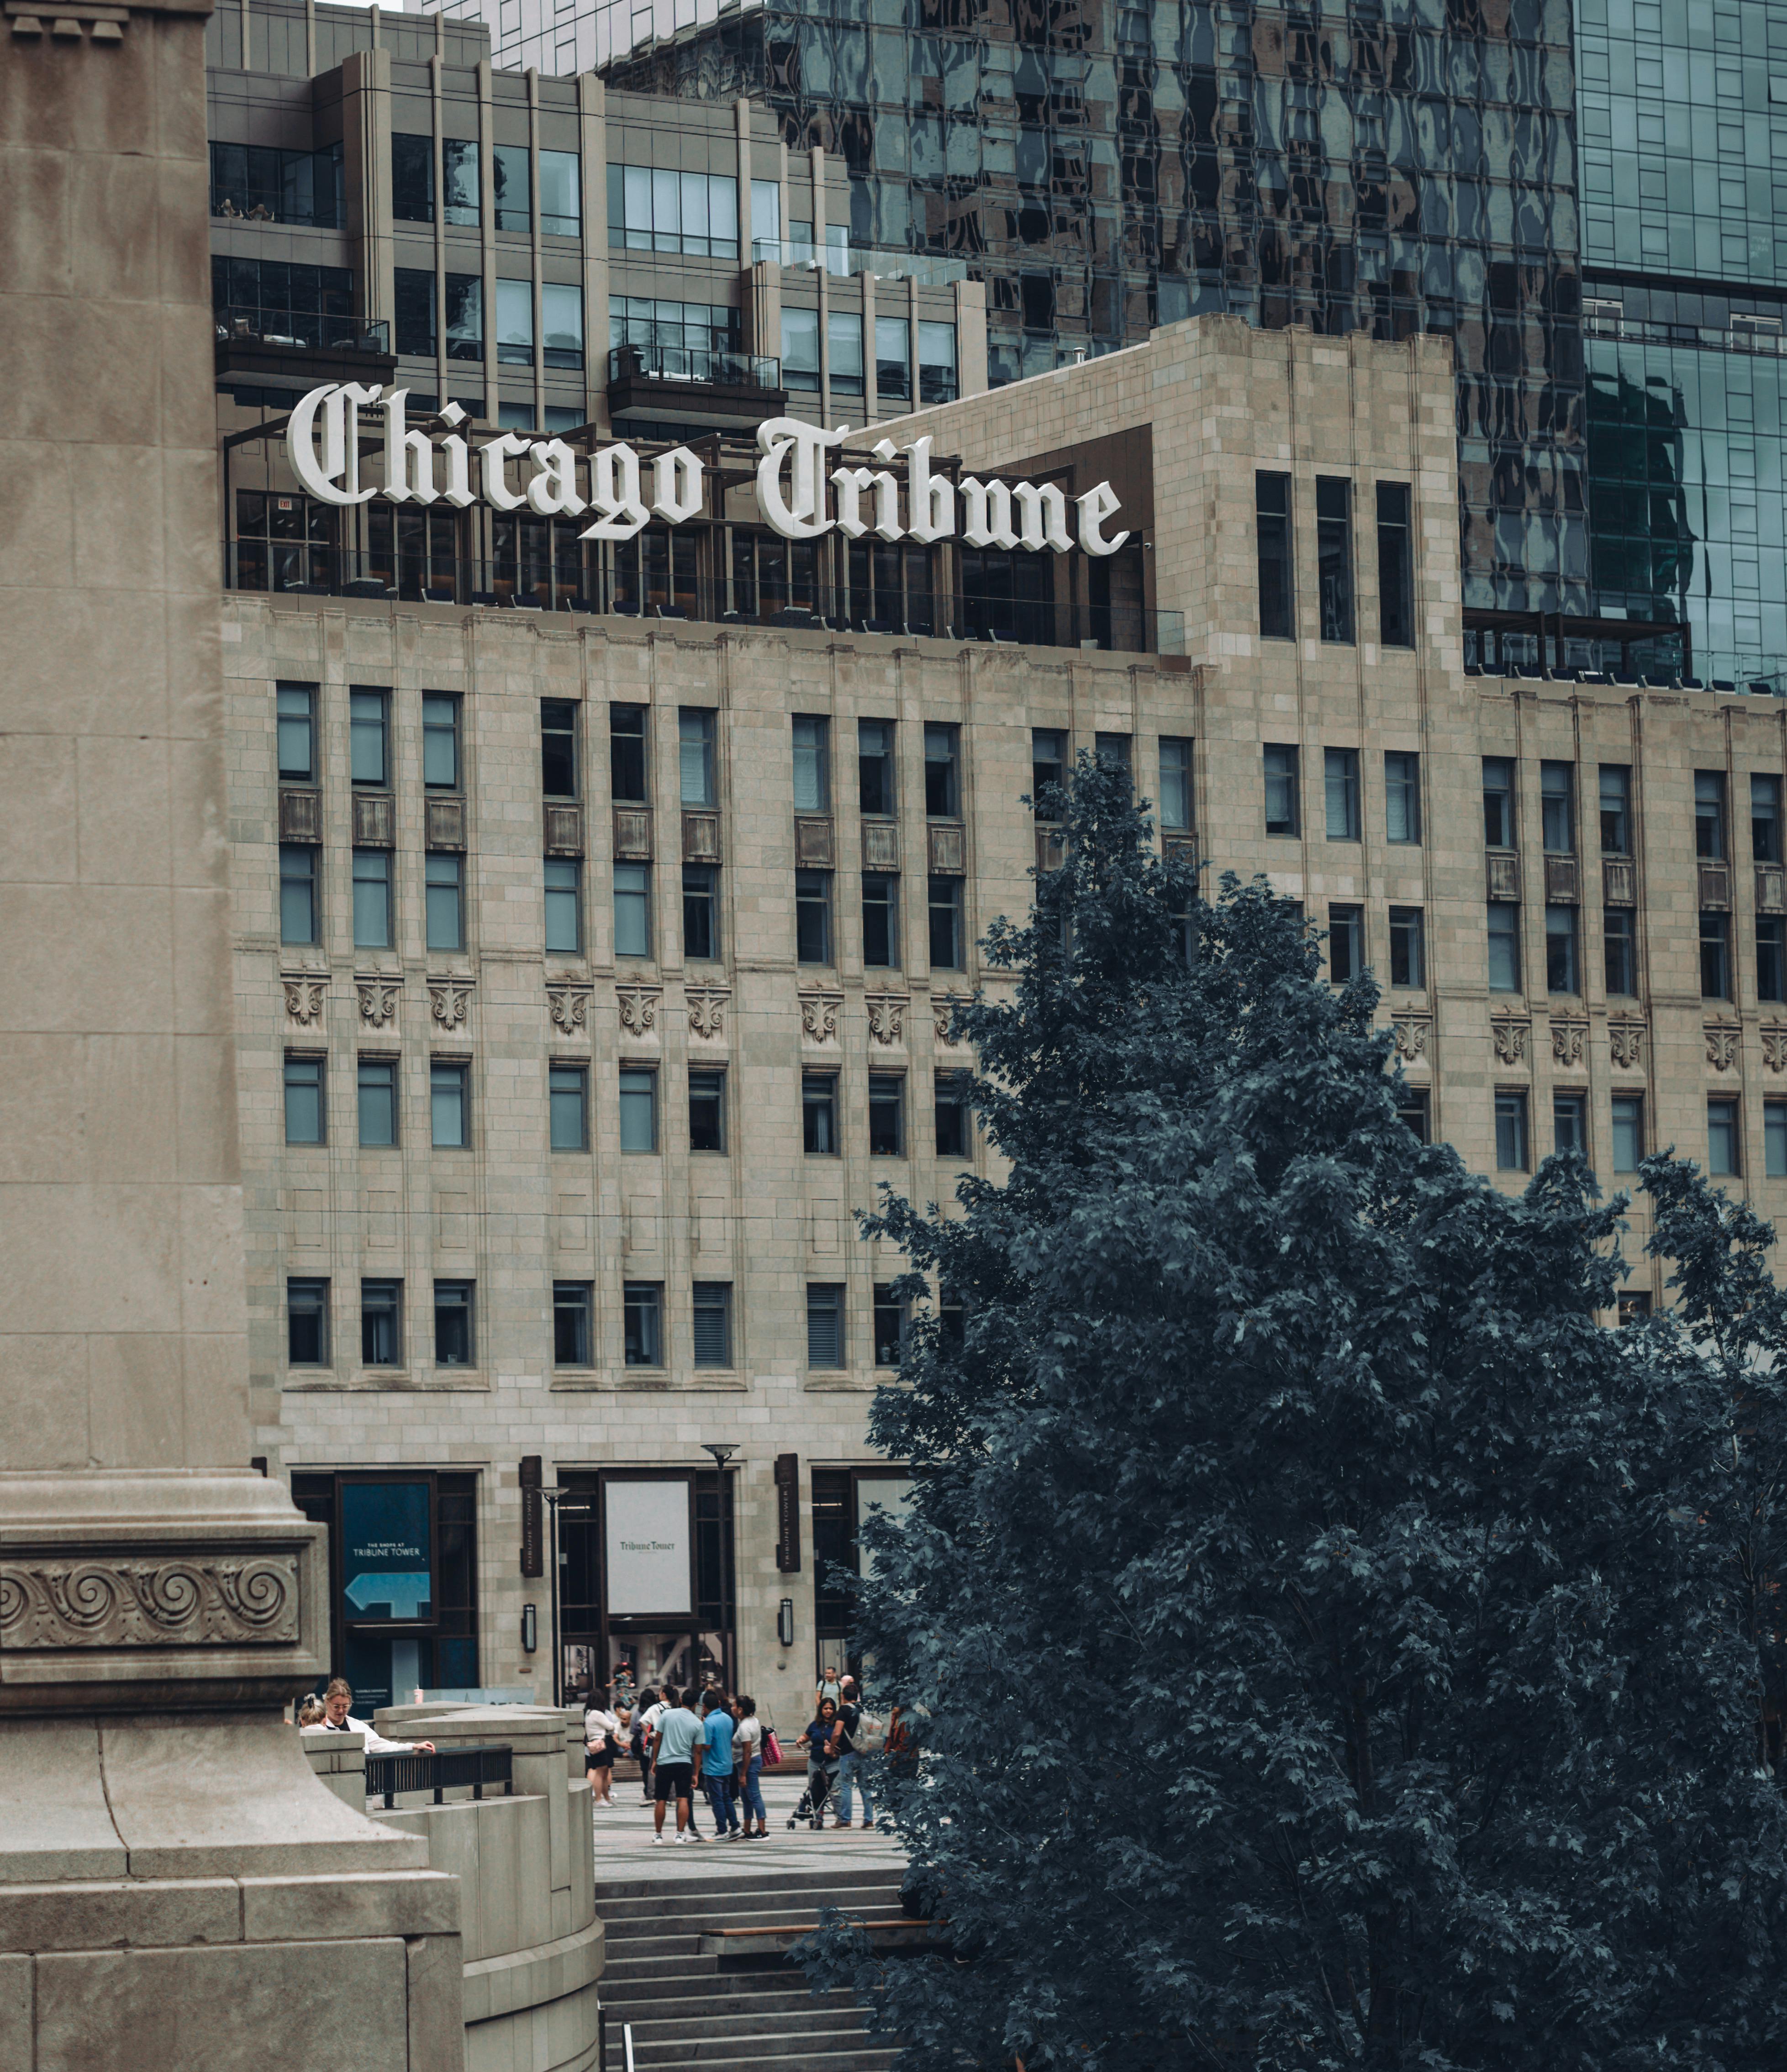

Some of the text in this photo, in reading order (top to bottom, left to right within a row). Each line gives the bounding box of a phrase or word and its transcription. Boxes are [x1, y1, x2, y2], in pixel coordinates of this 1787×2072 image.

[286, 381, 1131, 557] Chicago Tribune
[280, 500, 290, 508] EXIT
[620, 1541, 675, 1550] Tribune Tower
[353, 1548, 420, 1557] TRIBUNE TOWER
